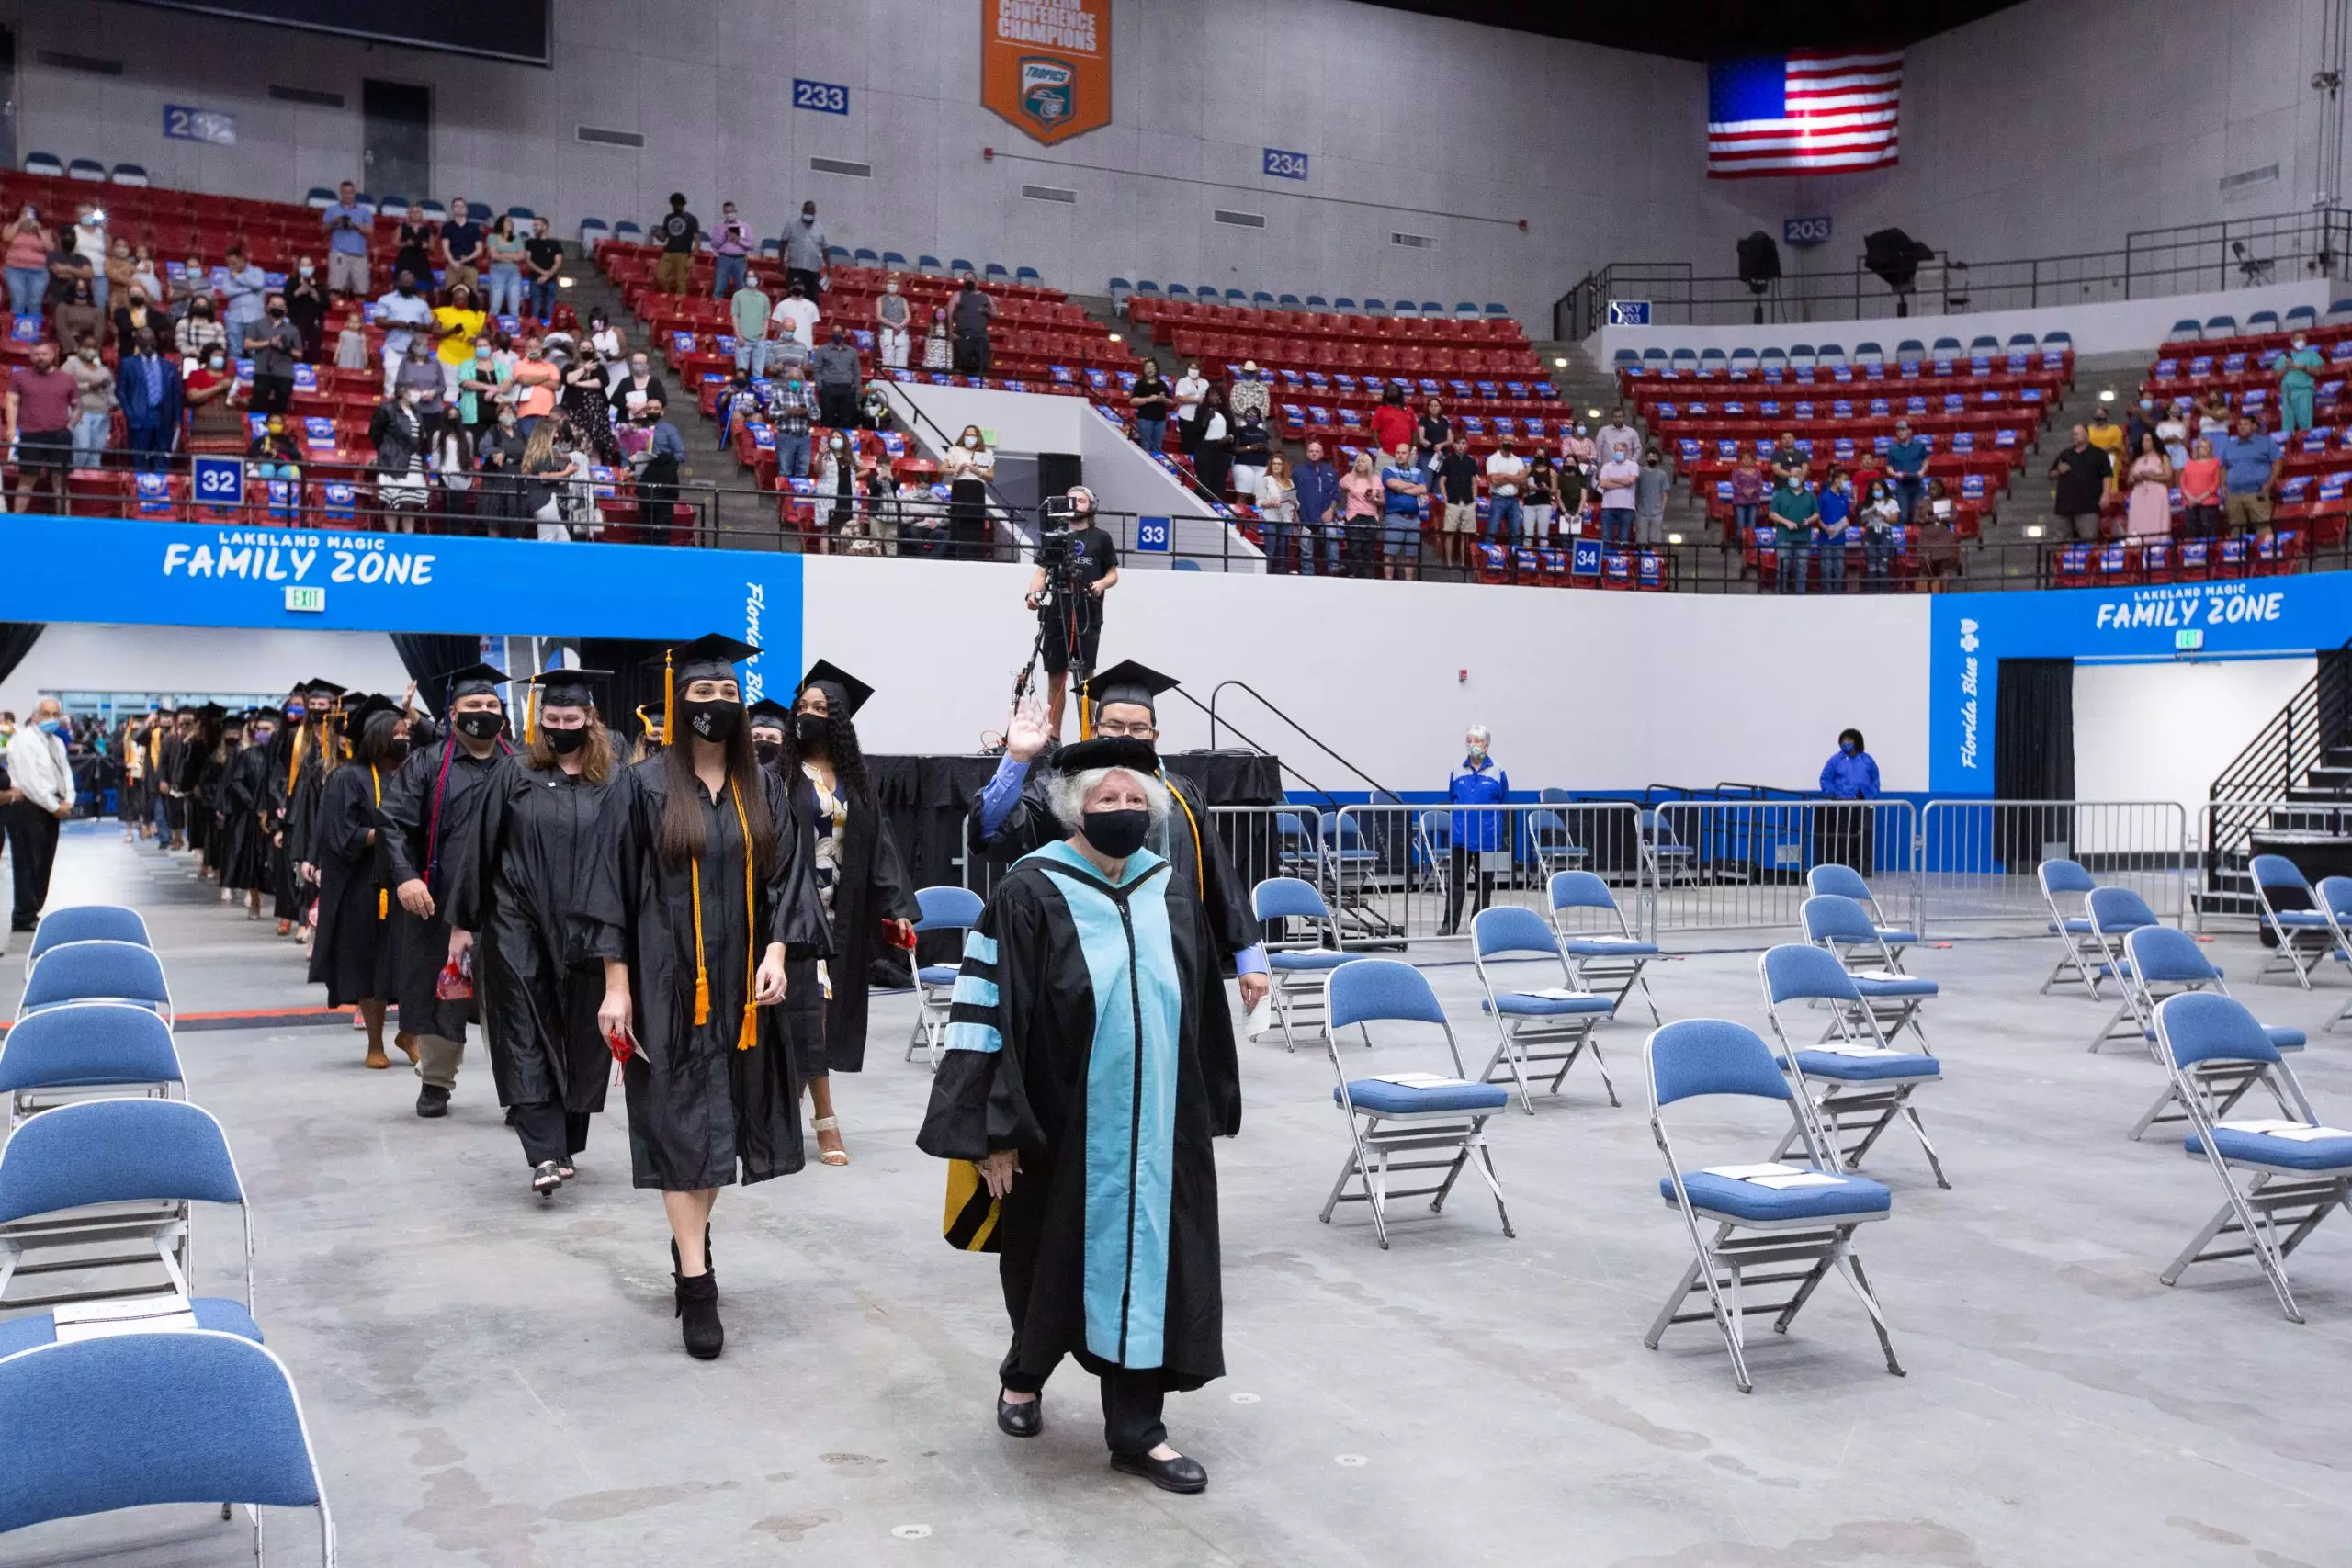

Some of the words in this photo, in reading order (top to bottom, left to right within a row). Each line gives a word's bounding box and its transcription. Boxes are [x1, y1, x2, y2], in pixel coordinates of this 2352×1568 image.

[999, 0, 1097, 32] CONFERENCE
[998, 17, 1097, 51] CHAMPIONS
[797, 84, 844, 110] 233
[1268, 152, 1306, 175] 234
[1788, 220, 1828, 239] 203
[202, 469, 235, 492] 32
[219, 531, 320, 548] LAKELAND
[327, 536, 385, 551] MAGIC
[1141, 525, 1164, 543] 33
[163, 543, 316, 581] FAMILY
[331, 551, 436, 586] ZONE
[1577, 550, 1596, 566] 34
[293, 588, 318, 607] EXIT
[2133, 587, 2201, 602] LAKELAND
[2206, 583, 2246, 597] MAGIC
[2096, 598, 2199, 629] FAMILY
[2207, 592, 2284, 625] ZONE
[1960, 657, 1978, 697] Blue
[1960, 698, 1978, 769] Florida
